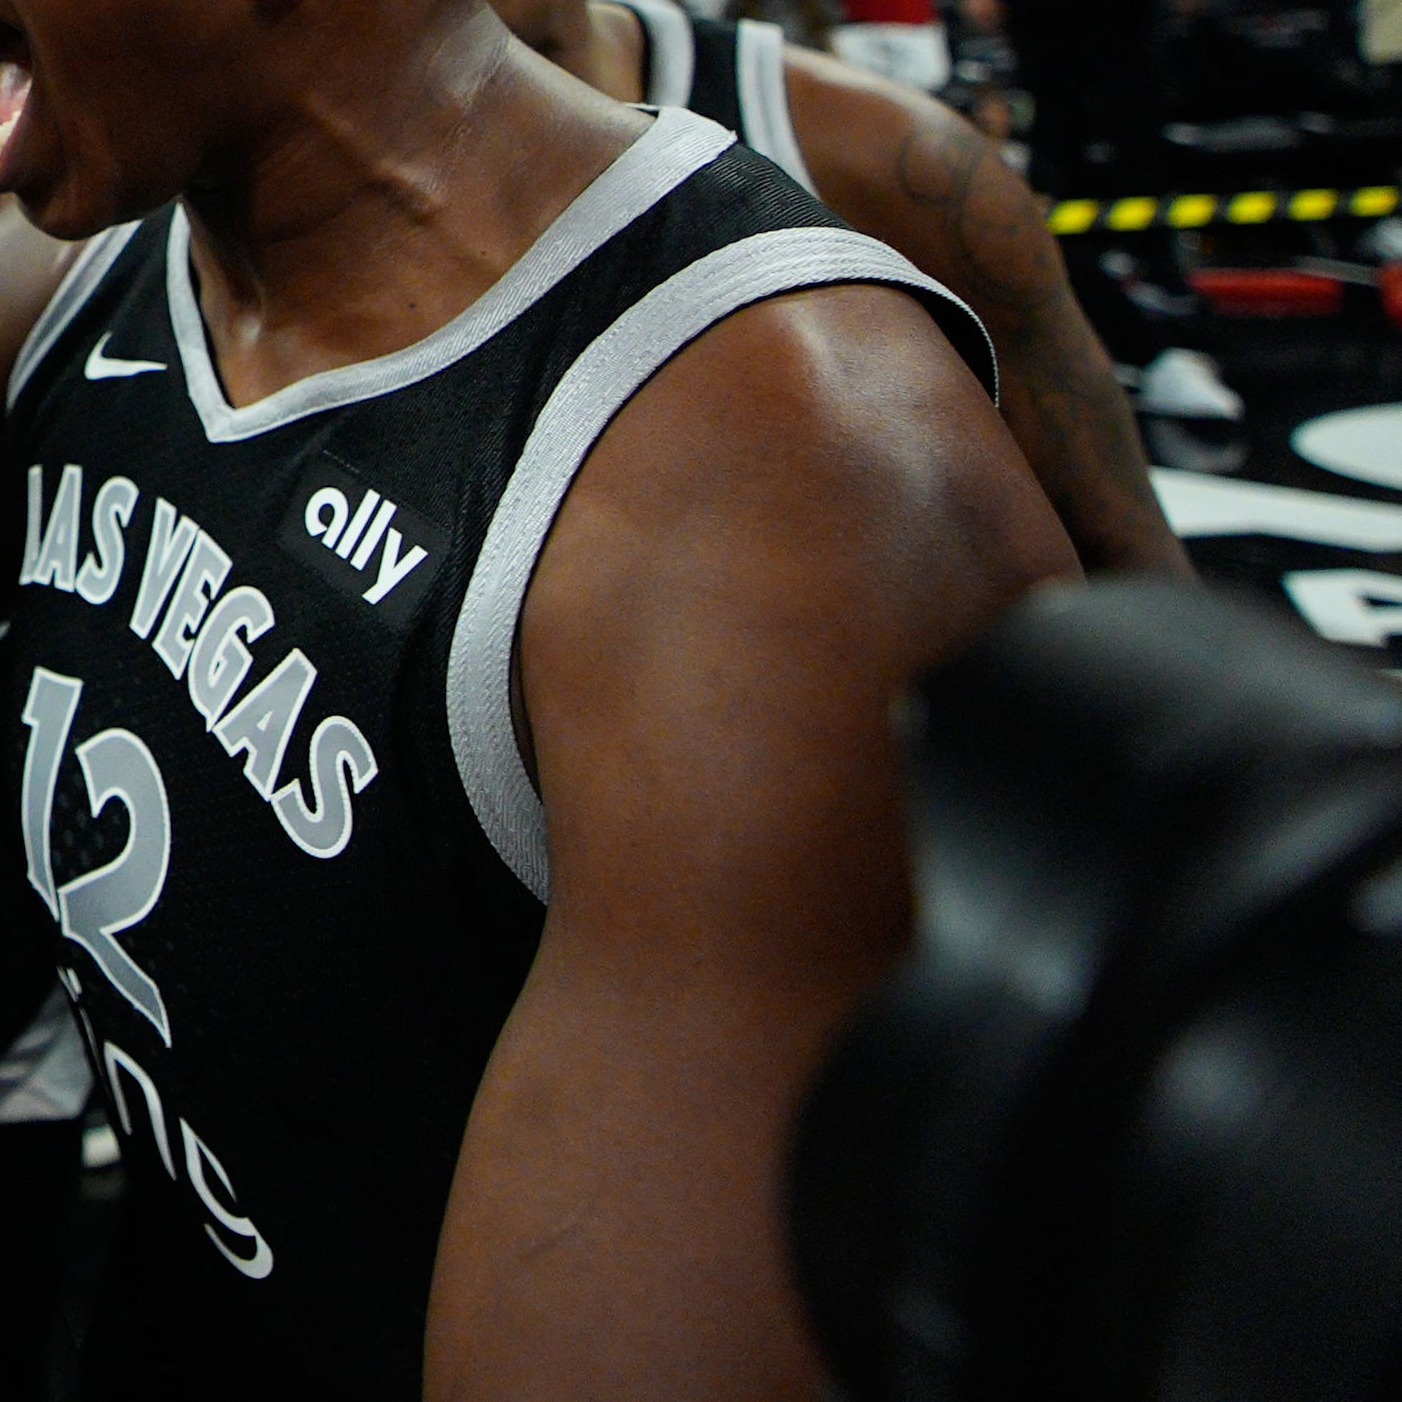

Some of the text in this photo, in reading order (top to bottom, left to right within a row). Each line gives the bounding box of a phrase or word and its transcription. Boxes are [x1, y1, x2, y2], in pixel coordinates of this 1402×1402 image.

[18, 463, 380, 859] LAS VEGAS
[304, 486, 429, 606] ally
[20, 666, 173, 1049] 12
